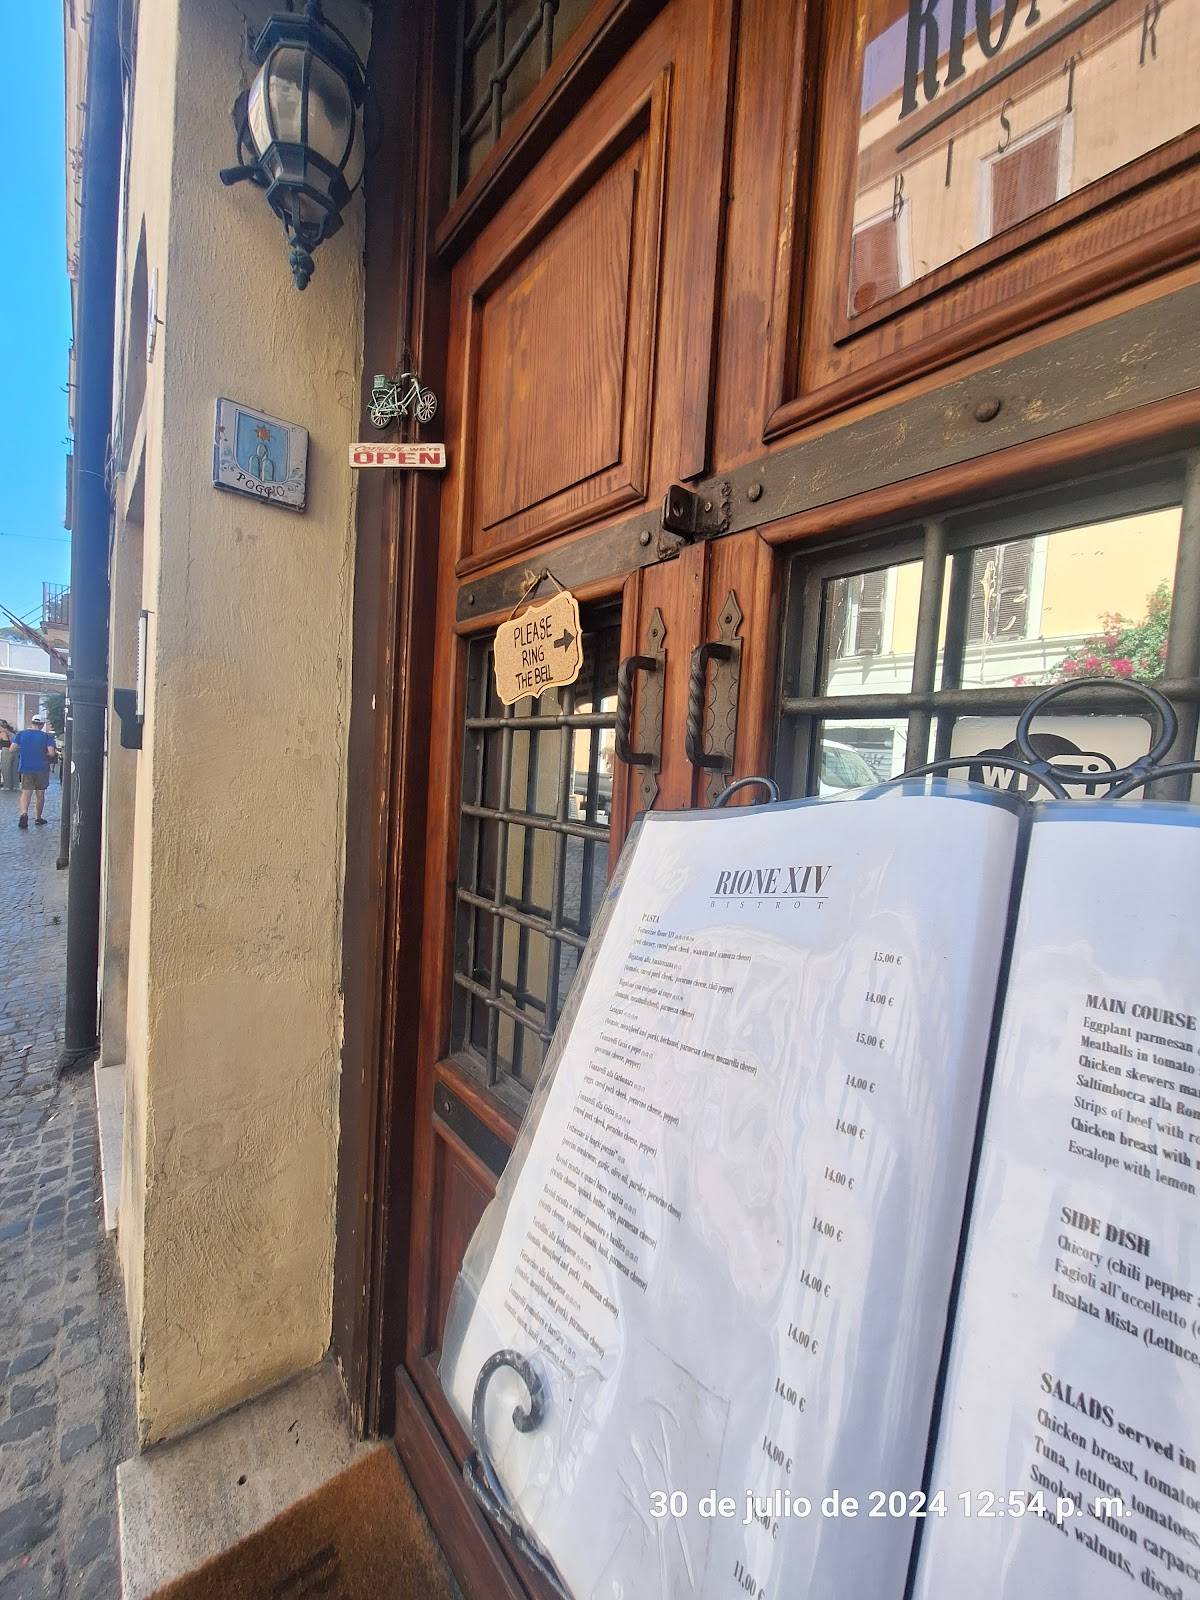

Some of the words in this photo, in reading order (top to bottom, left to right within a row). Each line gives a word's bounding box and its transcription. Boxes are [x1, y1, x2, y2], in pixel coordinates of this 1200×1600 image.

[353, 451, 441, 465] OPEN
[513, 615, 553, 648] PLEASE
[521, 645, 545, 669] RING
[515, 667, 533, 690] THE
[534, 664, 553, 688] BELL
[714, 867, 781, 895] RIONE
[782, 865, 832, 894] XIV
[874, 951, 895, 964] 15,00
[896, 955, 903, 966] €
[865, 991, 886, 1006] 14,00
[887, 995, 895, 1007] €
[1086, 994, 1127, 1015] MAIN
[1131, 1003, 1197, 1031] COURSE
[855, 1032, 877, 1048] 15,00
[878, 1038, 886, 1049] €
[1083, 1016, 1132, 1038] Eggplant
[1136, 1031, 1193, 1052] parmesan
[1081, 1035, 1133, 1058] Meatballs
[1137, 1048, 1149, 1062] in
[1152, 1053, 1195, 1075] tomato
[845, 1074, 867, 1091] 14,00
[869, 1082, 876, 1094] €
[1078, 1055, 1121, 1076] Chicken
[1126, 1067, 1175, 1091] skewers
[1076, 1074, 1146, 1104] Saltimbocca
[1150, 1093, 1172, 1112] alla
[835, 1119, 857, 1137] 14,00
[859, 1128, 866, 1139] €
[1074, 1095, 1107, 1117] Strips
[1111, 1107, 1125, 1121] of
[1127, 1111, 1152, 1130] beef
[1156, 1121, 1184, 1140] with
[1071, 1117, 1115, 1142] Chicken
[1120, 1129, 1158, 1156] breast
[1162, 1148, 1191, 1168] with
[824, 1166, 846, 1186] 14,00
[848, 1177, 855, 1190] €
[1068, 1140, 1120, 1168] Escalope
[1123, 1159, 1151, 1179] with
[1156, 1168, 1196, 1195] lemon
[812, 1217, 835, 1238] 14,00
[836, 1229, 844, 1242] €
[1060, 1206, 1101, 1237] SIDE
[1105, 1223, 1151, 1257] DISH
[800, 1270, 822, 1292] 14,00
[824, 1283, 831, 1298] €
[1054, 1257, 1096, 1289] Fagioli
[1058, 1234, 1103, 1268] Chicory
[1107, 1256, 1141, 1282] (chili
[1145, 1273, 1194, 1304] pepper
[1052, 1283, 1100, 1319] Insalata
[1105, 1307, 1139, 1337] Mista
[787, 1323, 810, 1349] 14,00
[811, 1340, 818, 1355] €
[775, 1377, 798, 1406] 14,00
[799, 1398, 806, 1413] €
[1040, 1372, 1114, 1428] SALADS
[1118, 1421, 1174, 1461] served
[1179, 1448, 1197, 1473] in
[1034, 1435, 1070, 1473] Tuna,
[1037, 1408, 1087, 1450] Chicken
[1091, 1438, 1138, 1481] breast,
[785, 1458, 793, 1475] €
[1074, 1527, 1136, 1580] walnuts,
